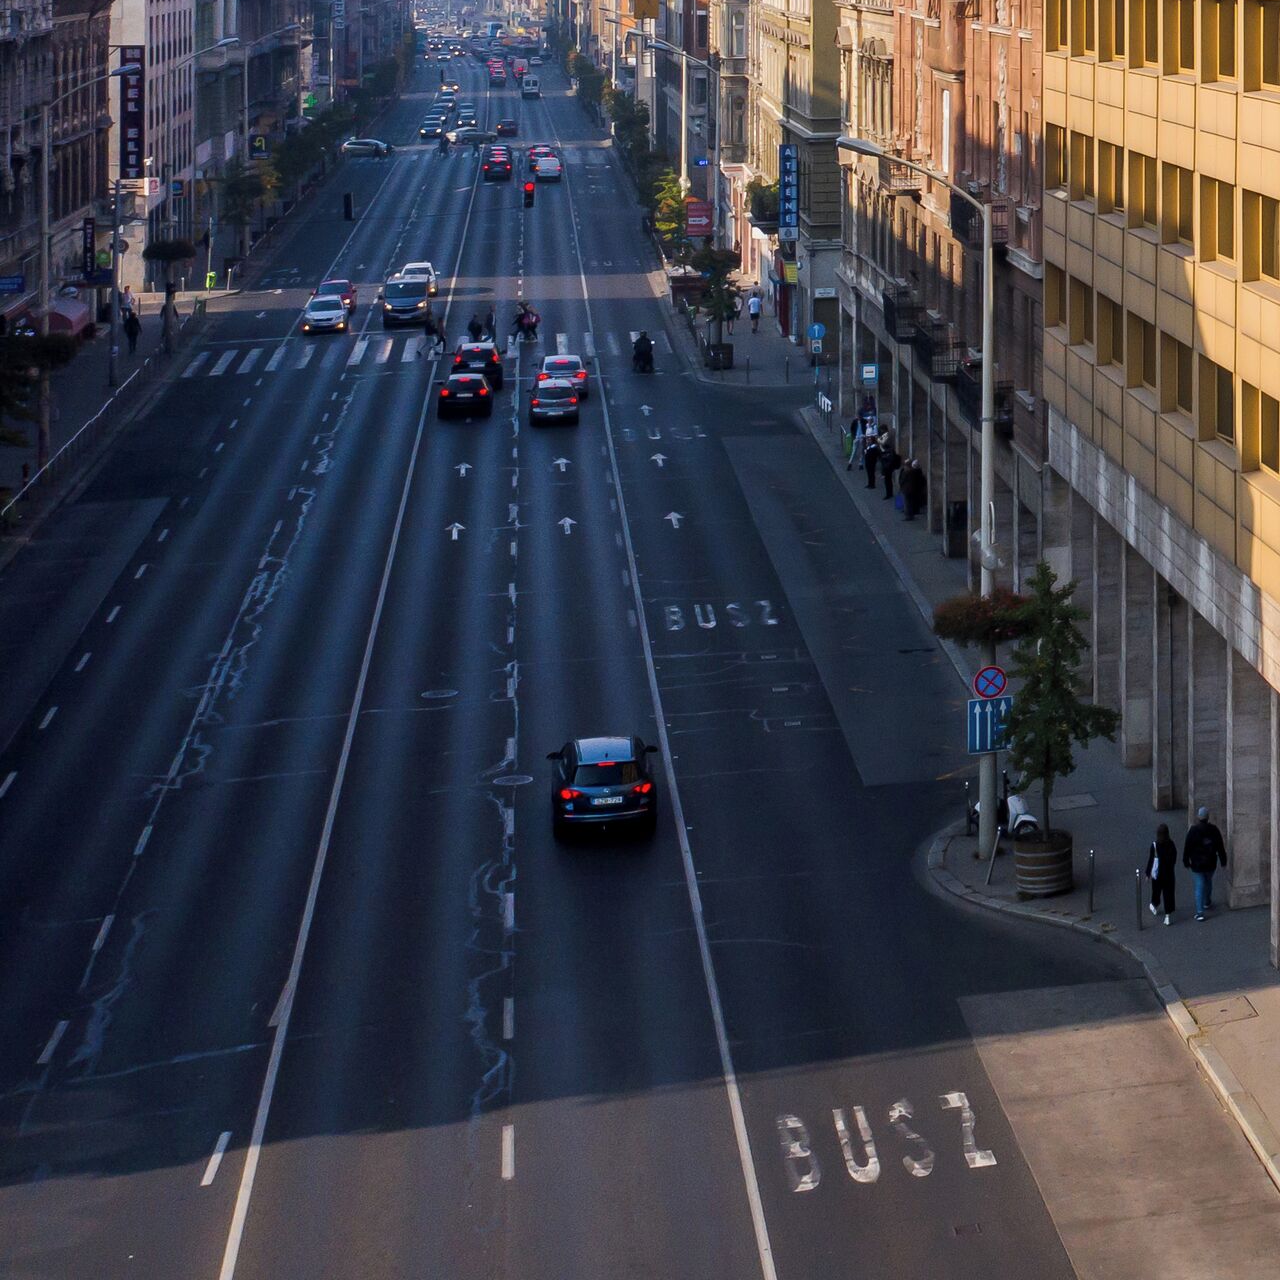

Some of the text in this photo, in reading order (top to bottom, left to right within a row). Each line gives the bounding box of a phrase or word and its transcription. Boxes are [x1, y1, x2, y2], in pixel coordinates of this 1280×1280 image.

[126, 48, 141, 112] HTEL
[664, 599, 780, 631] BUSZ
[776, 1091, 998, 1193] BUSZ
